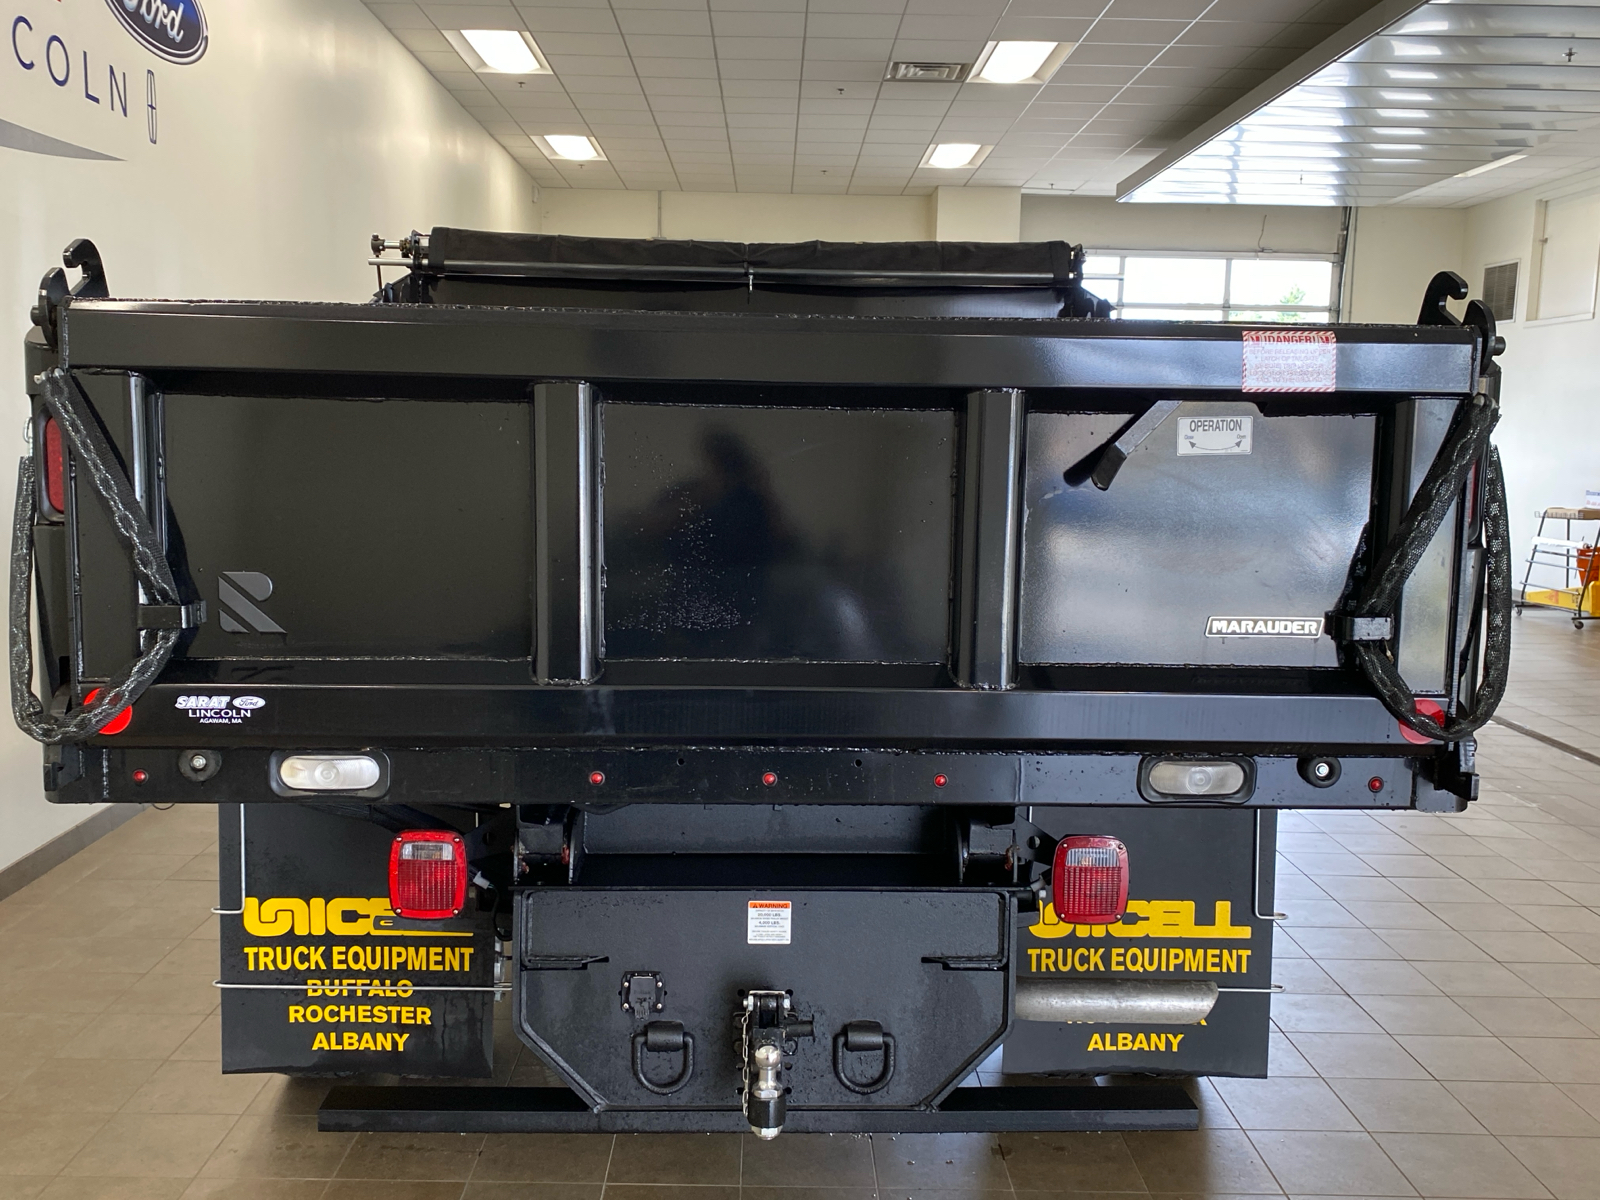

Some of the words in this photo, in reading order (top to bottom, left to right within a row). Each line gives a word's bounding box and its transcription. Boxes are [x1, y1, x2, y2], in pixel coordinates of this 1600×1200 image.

[1189, 419, 1243, 432] OPERATION
[1211, 620, 1318, 634] MARAUDER
[175, 695, 231, 709] SARAT
[188, 709, 252, 718] LINCOLN
[243, 945, 327, 971] TRUCK
[332, 945, 474, 972] EQUIPMENT
[1027, 948, 1105, 972] TRUCK
[1110, 948, 1252, 973] EQUIPMENT
[306, 979, 414, 998] BUFFALO
[288, 1005, 432, 1025] ROCHESTER
[311, 1032, 410, 1052] ALBANY
[1087, 1033, 1185, 1052] ALBANY
